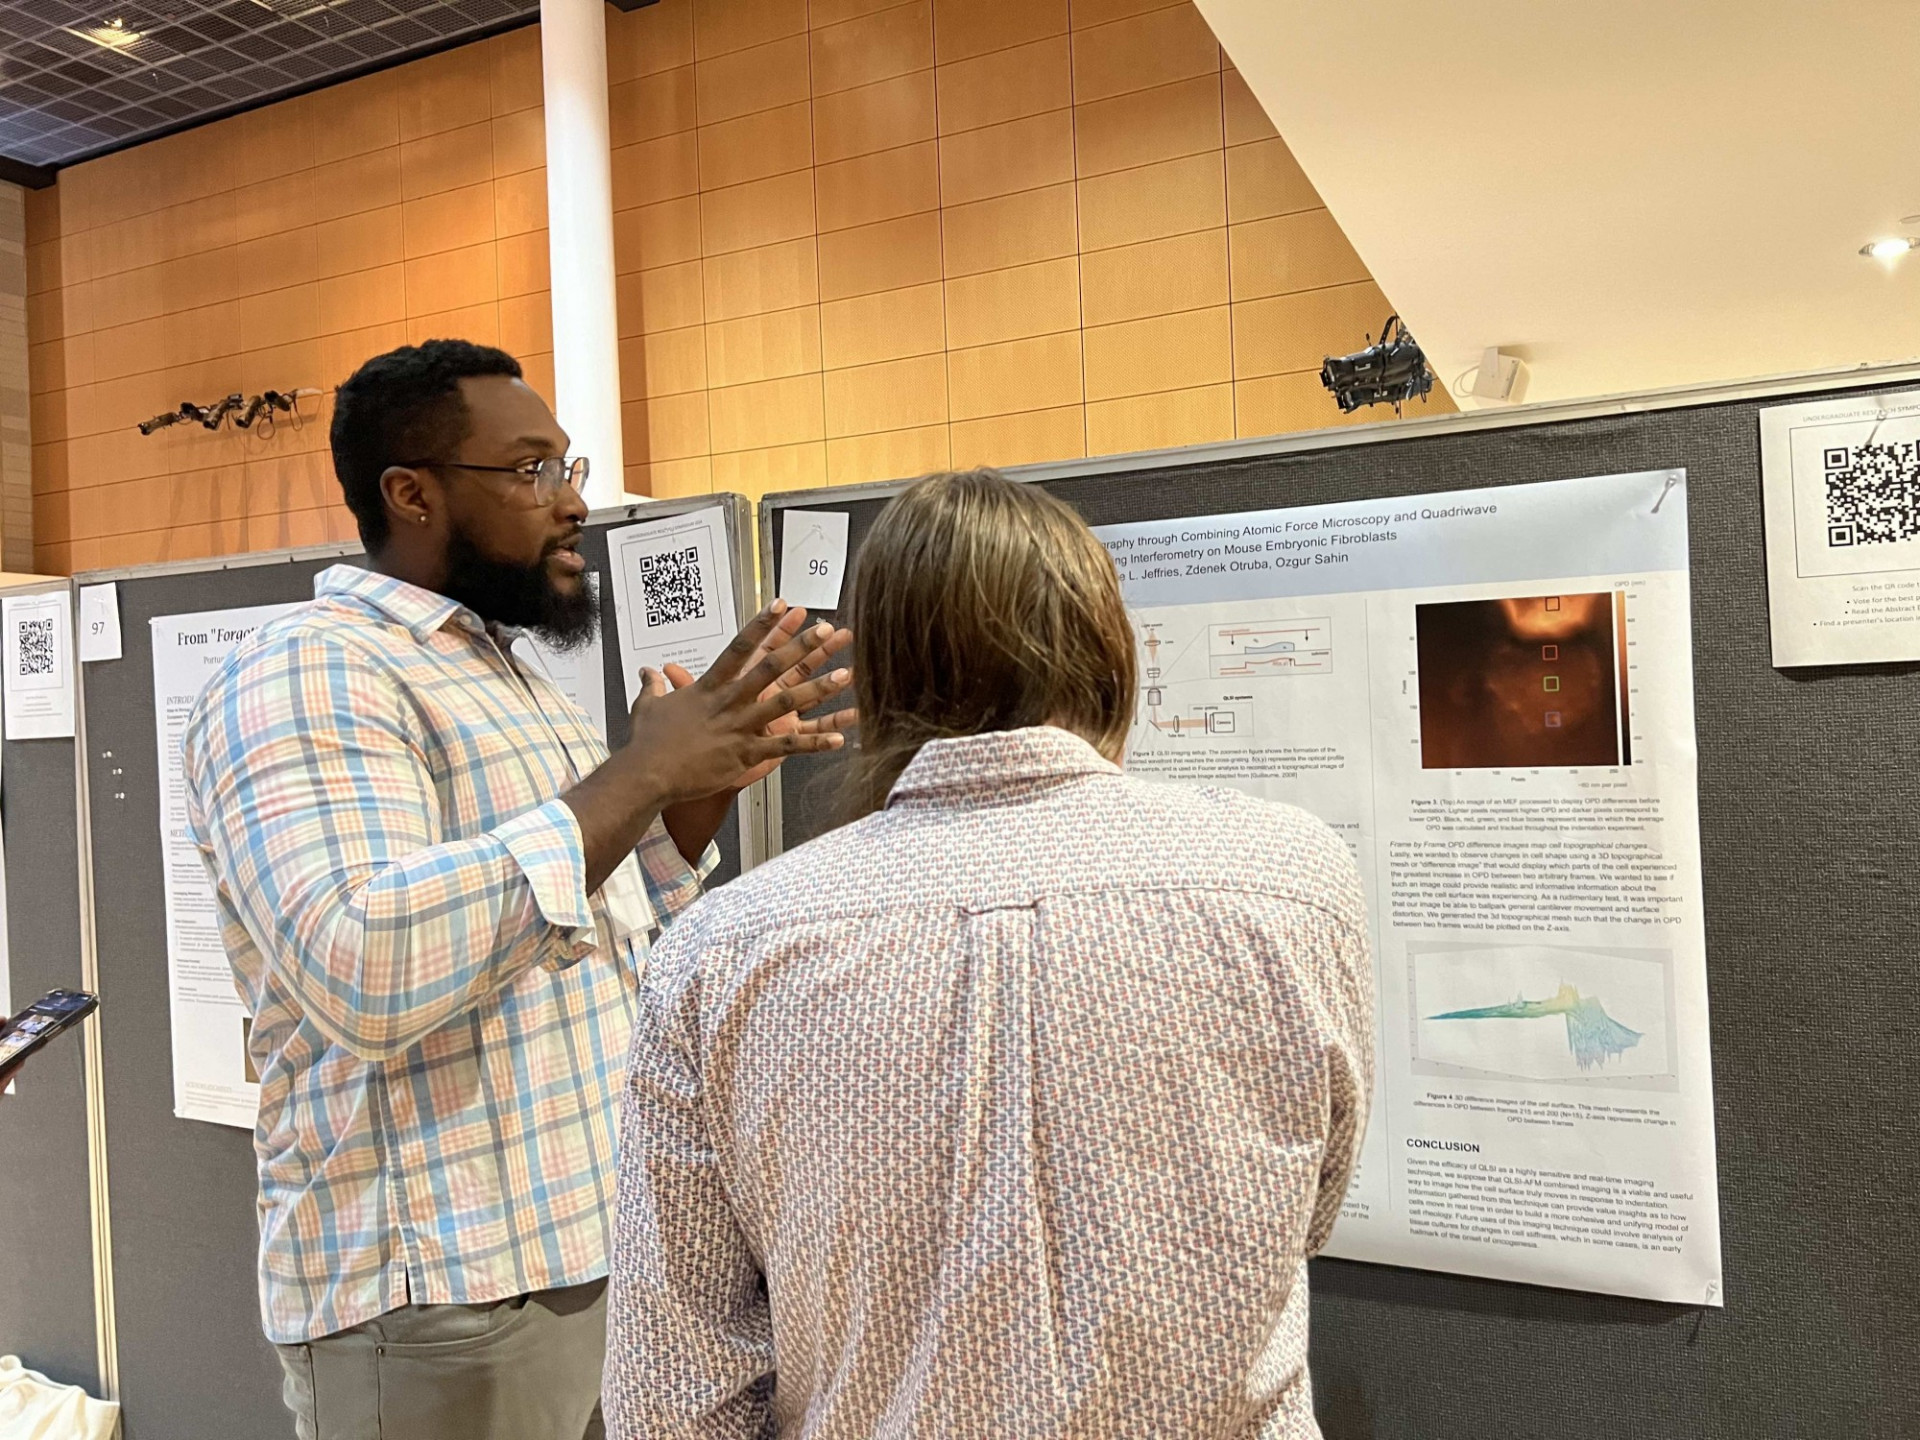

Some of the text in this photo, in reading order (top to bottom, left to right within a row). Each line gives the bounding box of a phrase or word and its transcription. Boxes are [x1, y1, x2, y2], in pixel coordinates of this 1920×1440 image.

[1803, 411, 1860, 422] UNDERGRADUATE
[1138, 534, 1177, 546] through
[1181, 529, 1239, 541] Combining
[1243, 524, 1281, 536] Atomic
[1286, 521, 1318, 532] Force
[1322, 514, 1390, 528] Microscopy
[1394, 510, 1416, 522] and
[1421, 504, 1497, 519] Quadriwave
[1131, 548, 1203, 564] Interferometry
[1207, 548, 1221, 556] on
[1225, 544, 1262, 554] Mouse
[1266, 536, 1327, 551] Embryonic
[1331, 531, 1397, 545] Fibroblasts
[809, 559, 828, 575] 96
[1129, 570, 1138, 580] L.
[1141, 567, 1182, 579] Jeffries,
[1185, 564, 1226, 576] Zdenek
[1230, 560, 1272, 572] Otruba,
[1276, 556, 1310, 568] Ozgur
[1315, 552, 1349, 564] Sahin
[92, 621, 104, 635] 97
[1843, 617, 1883, 626] presenter's
[178, 632, 208, 645] From
[1406, 1138, 1480, 1152] CONCLUSION
